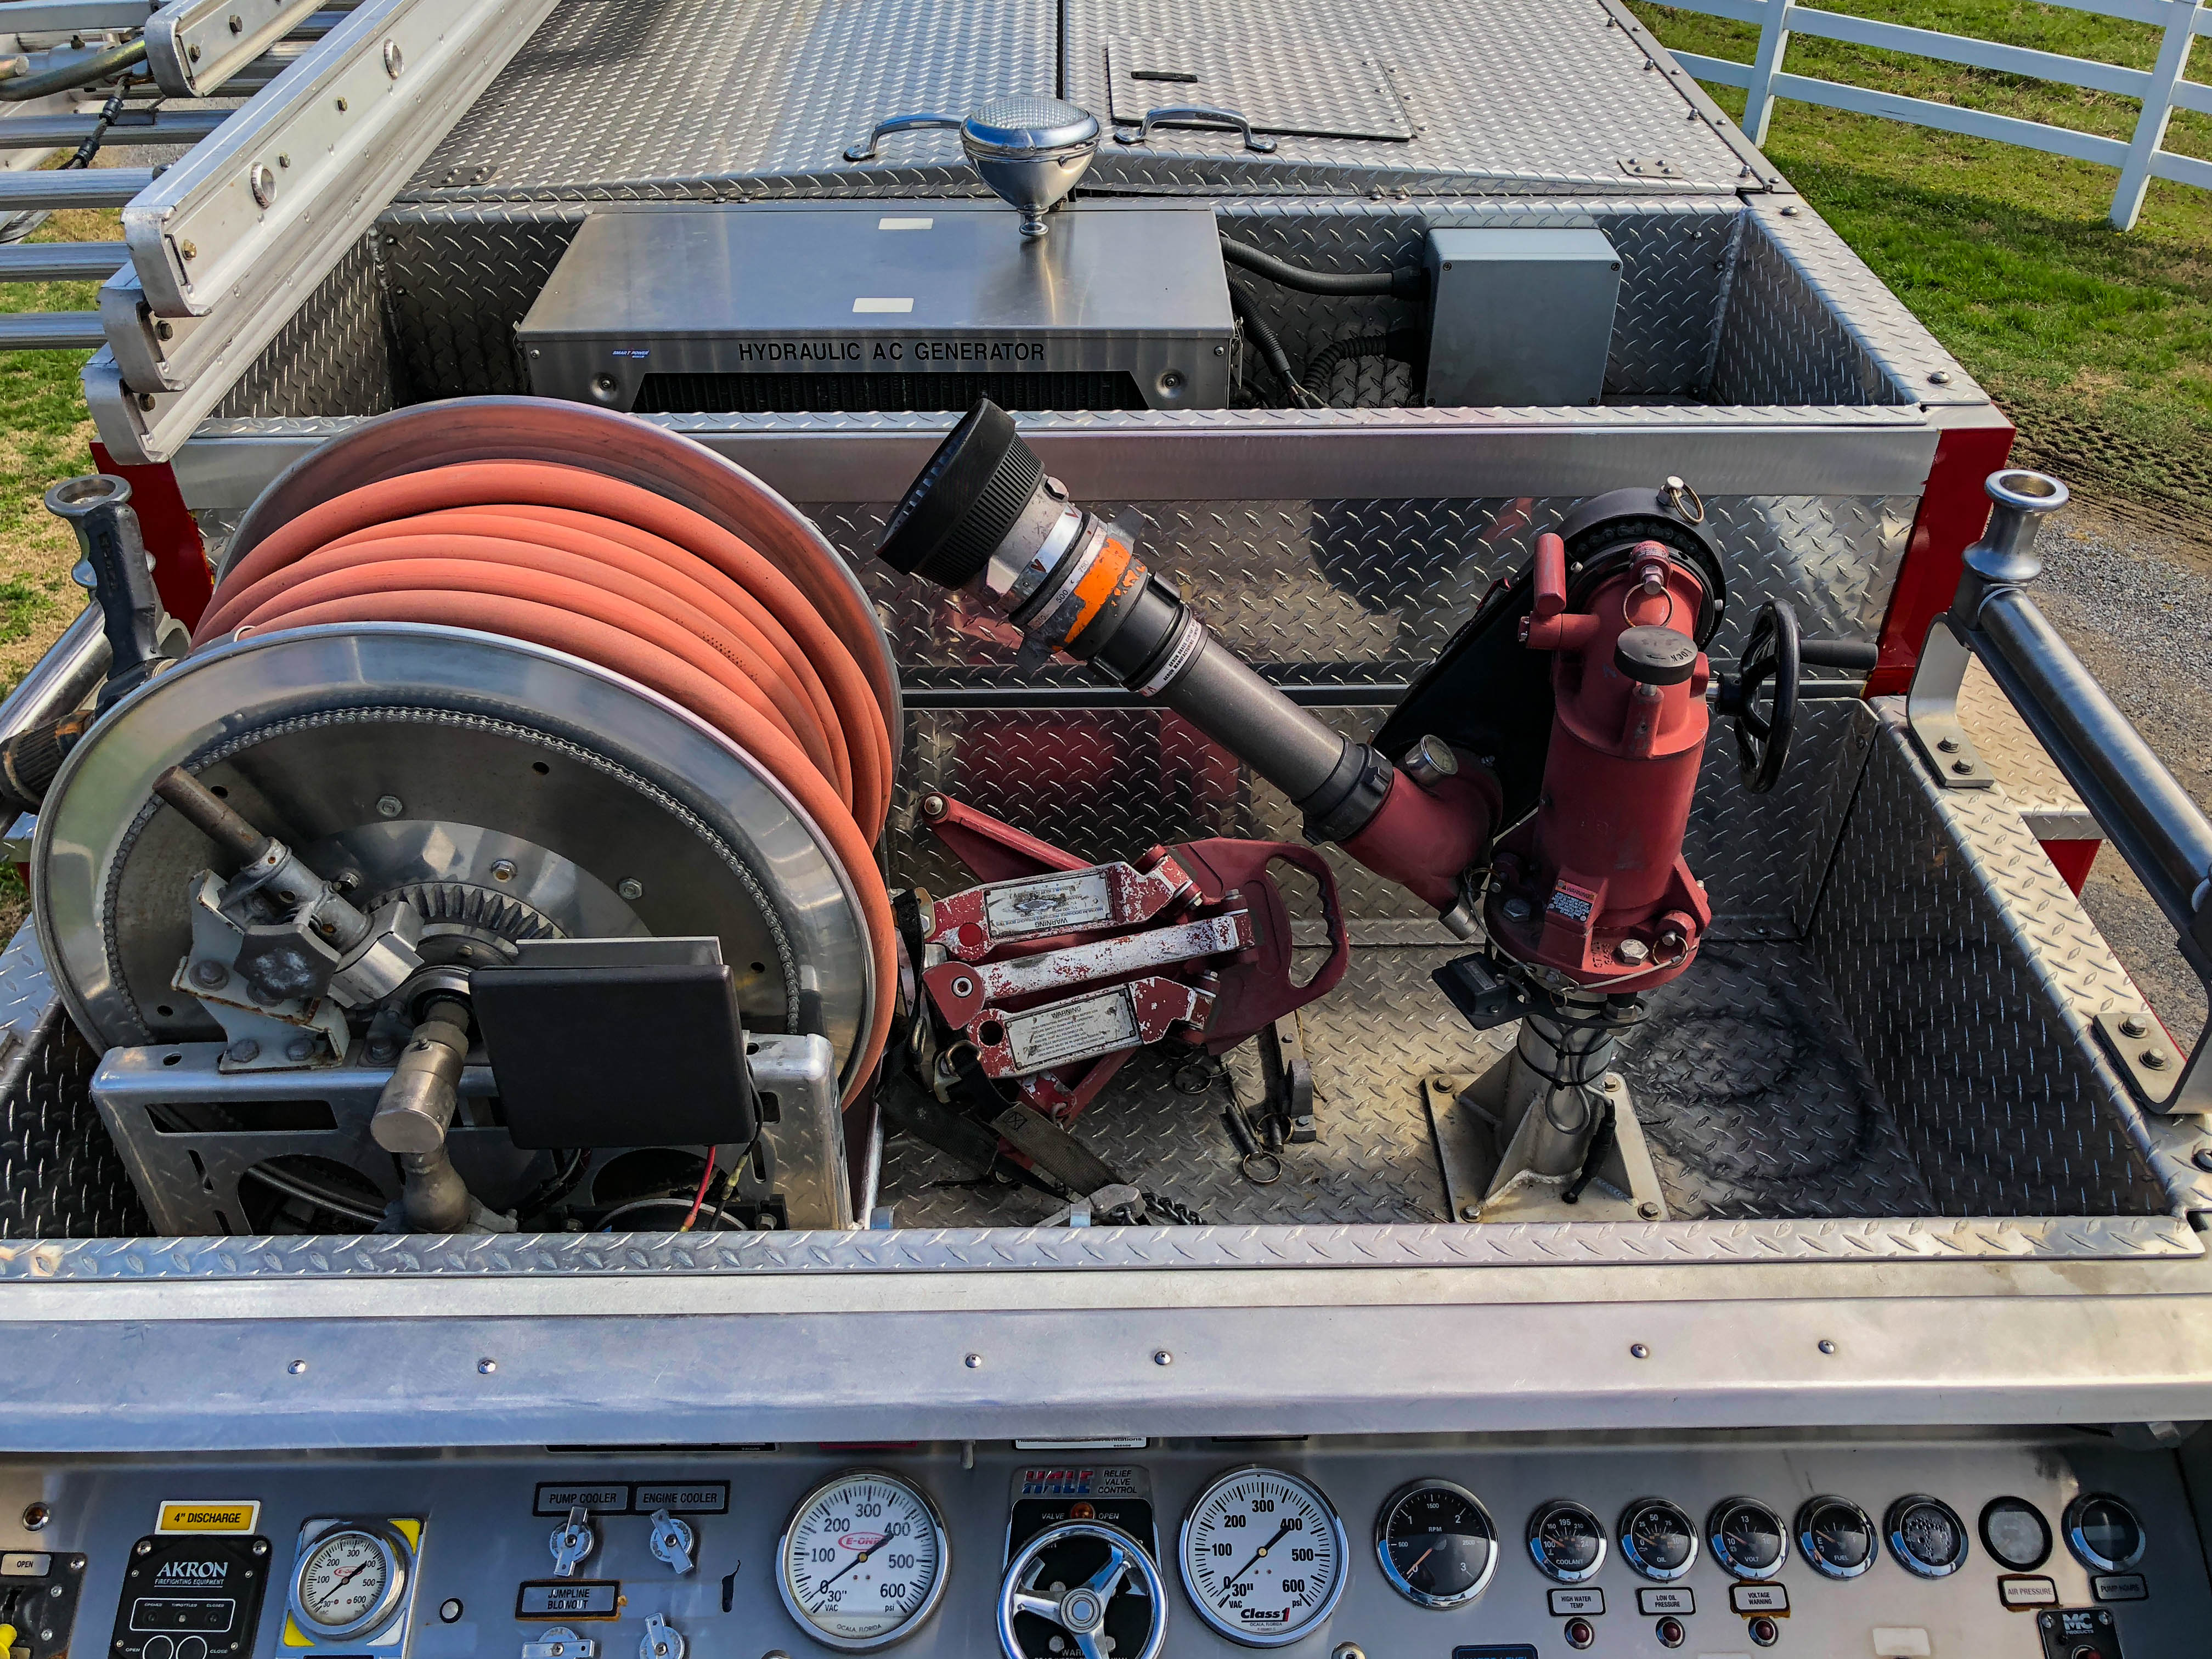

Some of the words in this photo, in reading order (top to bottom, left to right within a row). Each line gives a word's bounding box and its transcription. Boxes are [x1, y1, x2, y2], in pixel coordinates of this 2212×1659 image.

[739, 342, 860, 360] HYDRAULIC
[872, 342, 903, 360] AC
[915, 342, 1045, 360] GENERATOR
[1056, 589, 1069, 603] 500
[1163, 669, 1174, 681] AKRON
[1173, 639, 1195, 669] MANUFACTURING
[1169, 654, 1179, 667] AKRON
[1178, 641, 1187, 654] BRASS
[1671, 648, 1692, 662] LOCK
[1034, 917, 1067, 927] WARNING
[1051, 1006, 1081, 1019] WARNING
[1022, 1470, 1093, 1494] HALE
[549, 1493, 577, 1504] PUMP
[579, 1493, 617, 1503] COOLER
[643, 1493, 678, 1503] ENGINE
[680, 1492, 717, 1503] COOLER
[855, 1503, 881, 1517] 300
[1252, 1499, 1274, 1513] 300
[187, 1513, 241, 1523] DISCHARGE
[1224, 1515, 1246, 1527] 200
[1280, 1518, 1302, 1531] 400
[1408, 1516, 1412, 1524] 1
[1455, 1515, 1460, 1523] 2
[824, 1518, 850, 1532] 200
[884, 1522, 911, 1536] 400
[811, 1548, 835, 1562] 100
[1212, 1543, 1232, 1556] 100
[1291, 1548, 1313, 1561] 500
[888, 1554, 914, 1568] 500
[1460, 1562, 1466, 1571] 3
[156, 1562, 228, 1577] AKRON
[820, 1580, 828, 1594] 0
[1223, 1576, 1231, 1589] 0
[1282, 1579, 1305, 1593] 600
[548, 1589, 590, 1599] JUMPLINE
[880, 1583, 906, 1598] 600
[548, 1600, 588, 1610] BLOWOUT
[885, 1604, 894, 1612] psi
[1293, 1599, 1302, 1608] psi
[859, 1624, 882, 1632] FLORIDA
[2062, 1613, 2093, 1630] MC
